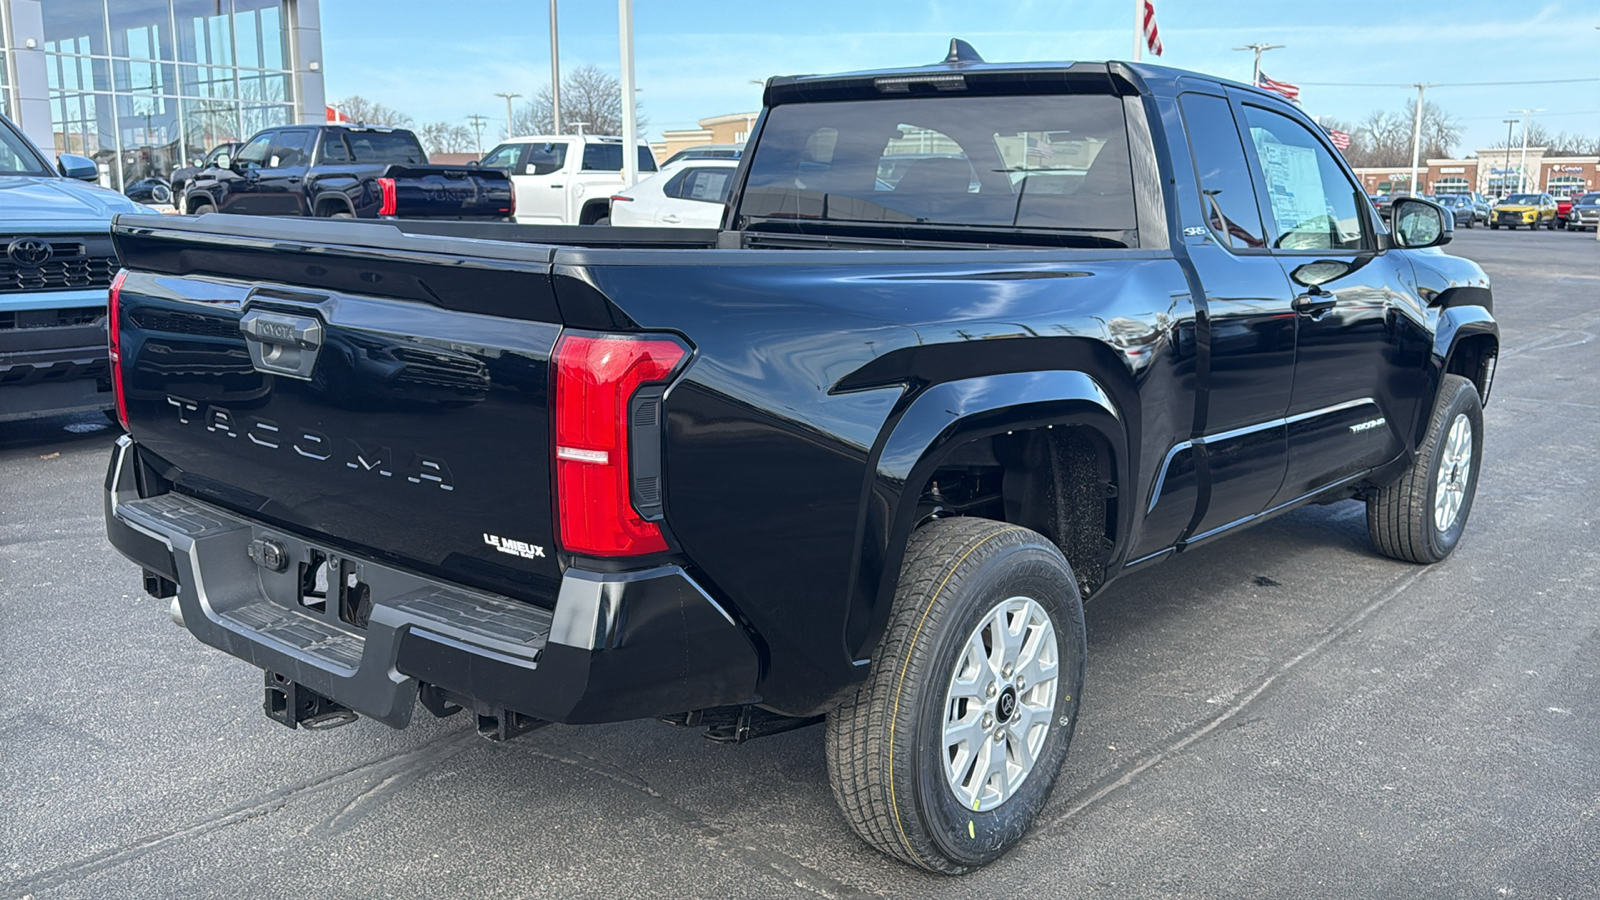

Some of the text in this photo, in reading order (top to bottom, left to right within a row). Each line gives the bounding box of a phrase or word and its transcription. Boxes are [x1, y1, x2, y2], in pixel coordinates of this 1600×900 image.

[1183, 226, 1206, 236] SR5
[257, 322, 294, 339] TOYOTA
[166, 394, 454, 491] TACOMA
[483, 533, 546, 557] LE MIEUX
